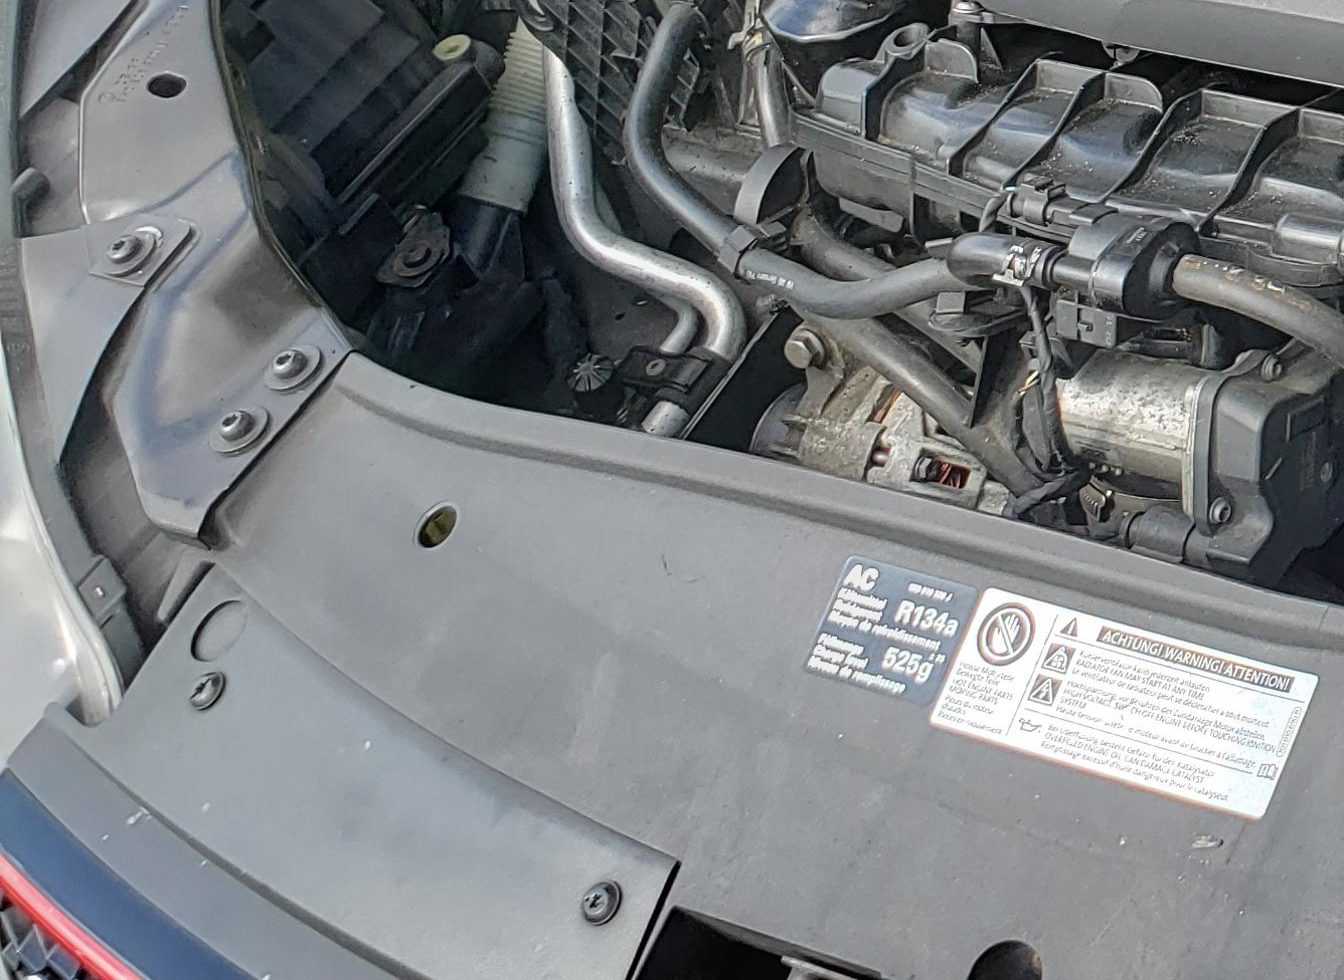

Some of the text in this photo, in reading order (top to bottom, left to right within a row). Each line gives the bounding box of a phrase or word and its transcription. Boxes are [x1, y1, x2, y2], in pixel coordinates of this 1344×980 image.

[844, 564, 879, 590] AC
[894, 600, 960, 636] R134a
[882, 647, 935, 684] 525g
[1103, 630, 1289, 690] ACHTUNG! WARNING! ATTENTION!
